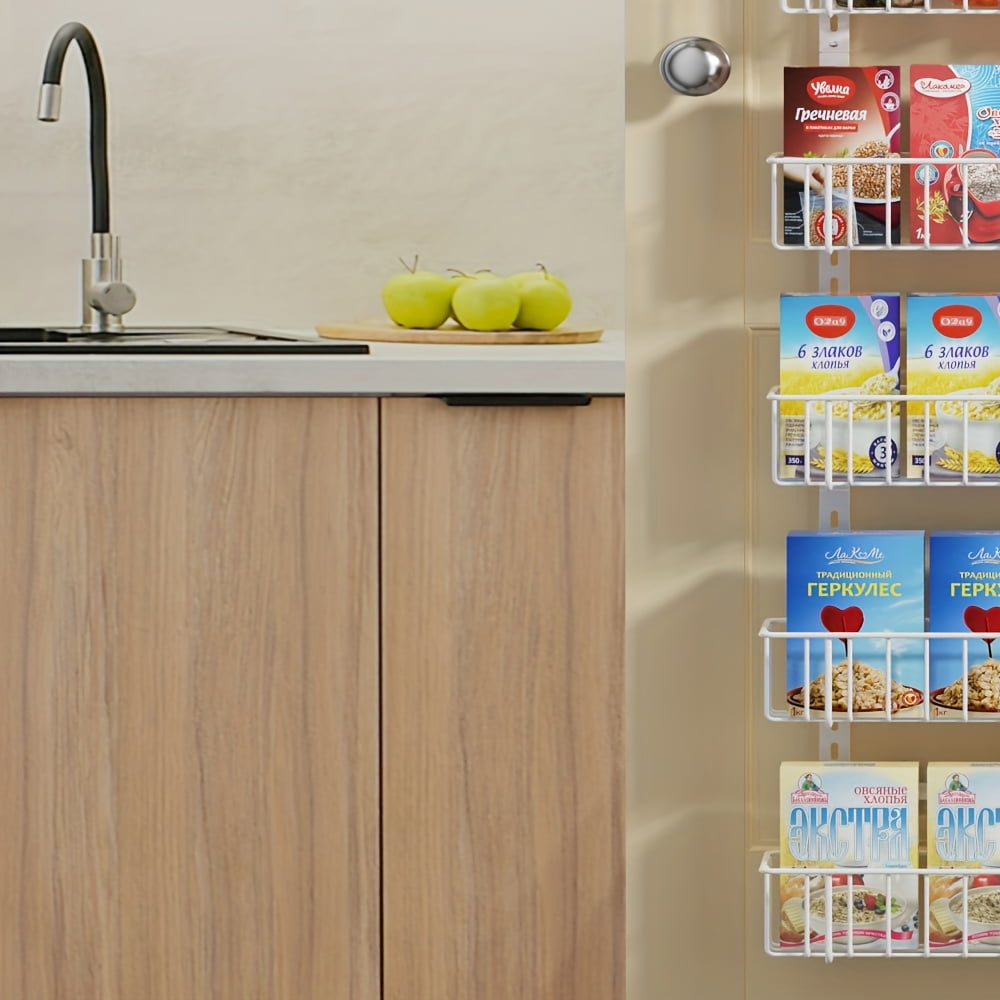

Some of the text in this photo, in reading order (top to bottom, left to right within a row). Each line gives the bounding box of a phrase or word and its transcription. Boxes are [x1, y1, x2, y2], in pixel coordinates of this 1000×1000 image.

[795, 107, 868, 123] Гречневая
[797, 343, 863, 358] 6 злаков
[924, 343, 990, 358] 6 злаков
[811, 360, 850, 370] хлопья
[938, 360, 977, 370] хлопья
[816, 571, 893, 580] ТРАДИЦИОННЫЙ
[807, 582, 902, 597] ГЕРКУЛЕС
